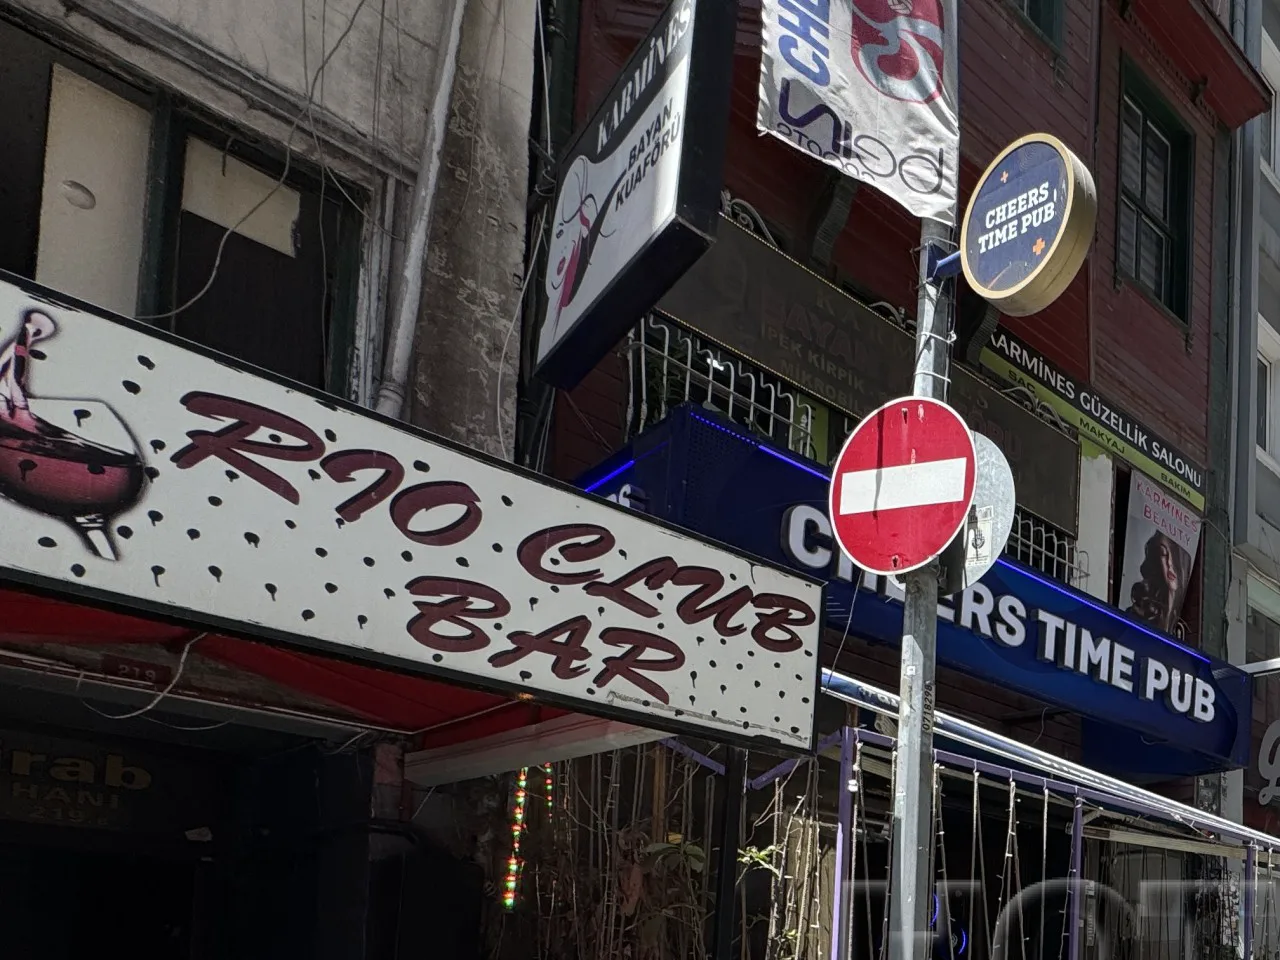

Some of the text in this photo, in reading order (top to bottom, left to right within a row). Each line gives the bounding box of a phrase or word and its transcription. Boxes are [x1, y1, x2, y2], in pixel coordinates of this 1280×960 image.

[615, 111, 681, 211] KUAFÖRÜ
[628, 98, 674, 171] BAYAN
[978, 201, 1056, 254] TIME PUB
[985, 182, 1049, 229] CHEERS
[1079, 417, 1126, 454] MAKYAJ
[1160, 472, 1191, 499] BAKIM
[1080, 392, 1148, 452] GÜZELLİK
[1151, 441, 1202, 489] SALONU
[1143, 505, 1192, 546] BEAUTY
[518, 523, 816, 654] CLUB
[118, 664, 156, 681] 219
[405, 575, 685, 706] BAR
[1036, 607, 1136, 692] TIME
[1144, 656, 1217, 722] PUB
